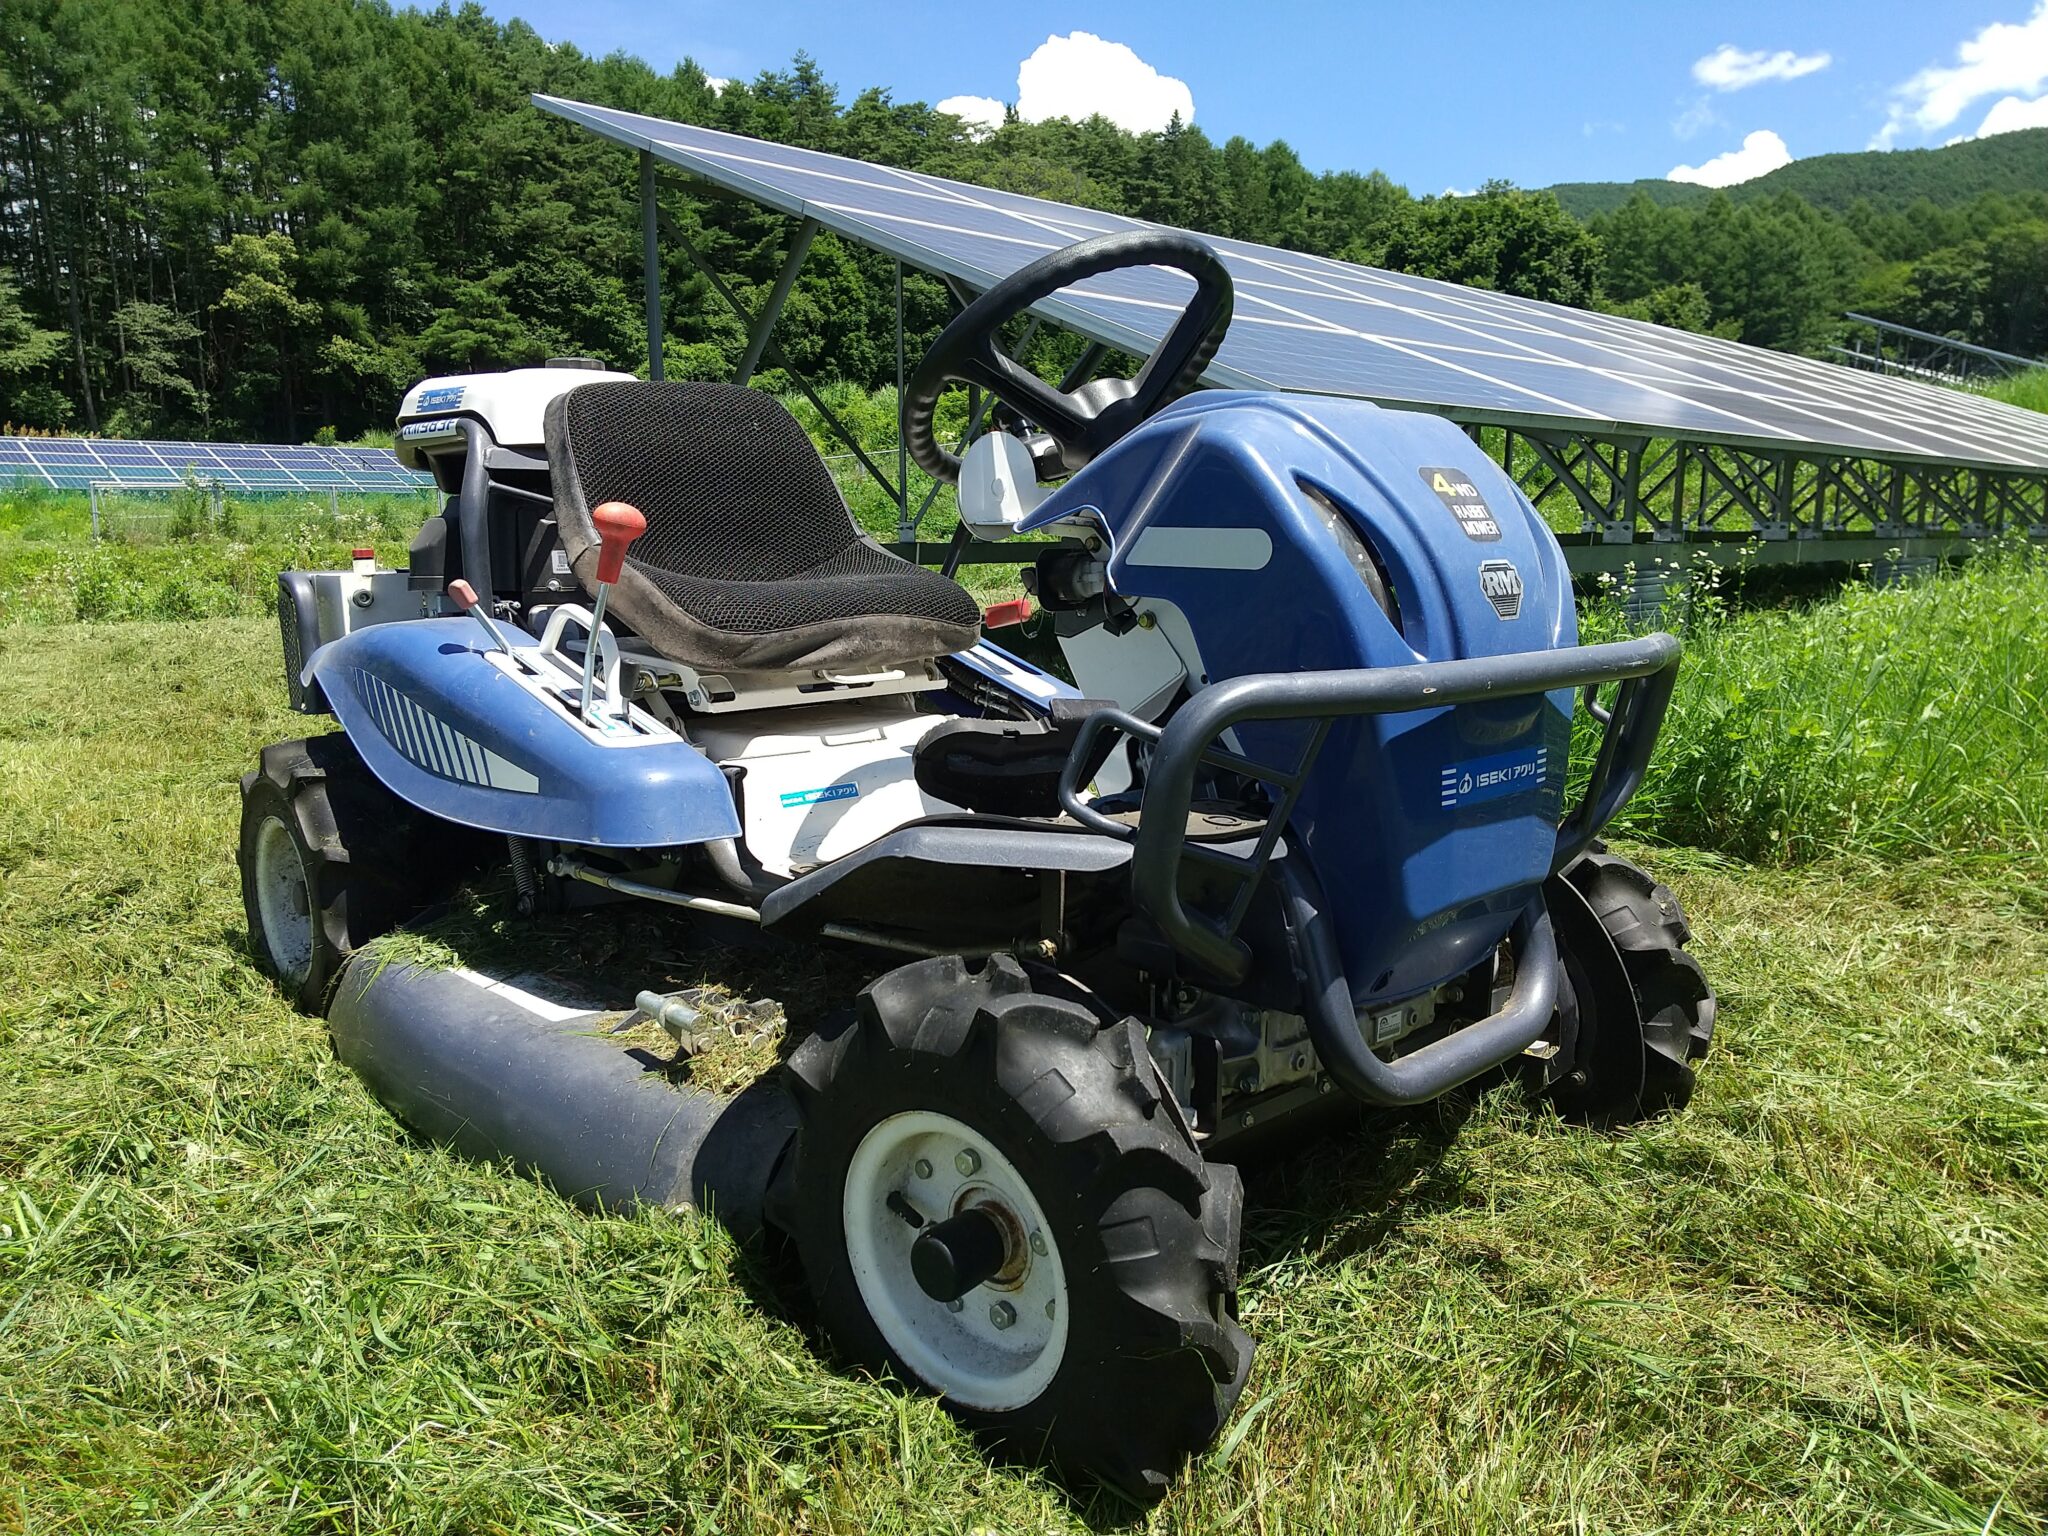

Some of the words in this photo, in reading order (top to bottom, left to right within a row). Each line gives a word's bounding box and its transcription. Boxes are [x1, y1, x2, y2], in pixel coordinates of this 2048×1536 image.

[1433, 473, 1478, 497] 4WD
[1452, 504, 1490, 519] RABBIT
[1461, 520, 1500, 536] MOWER
[1482, 570, 1521, 597] RM
